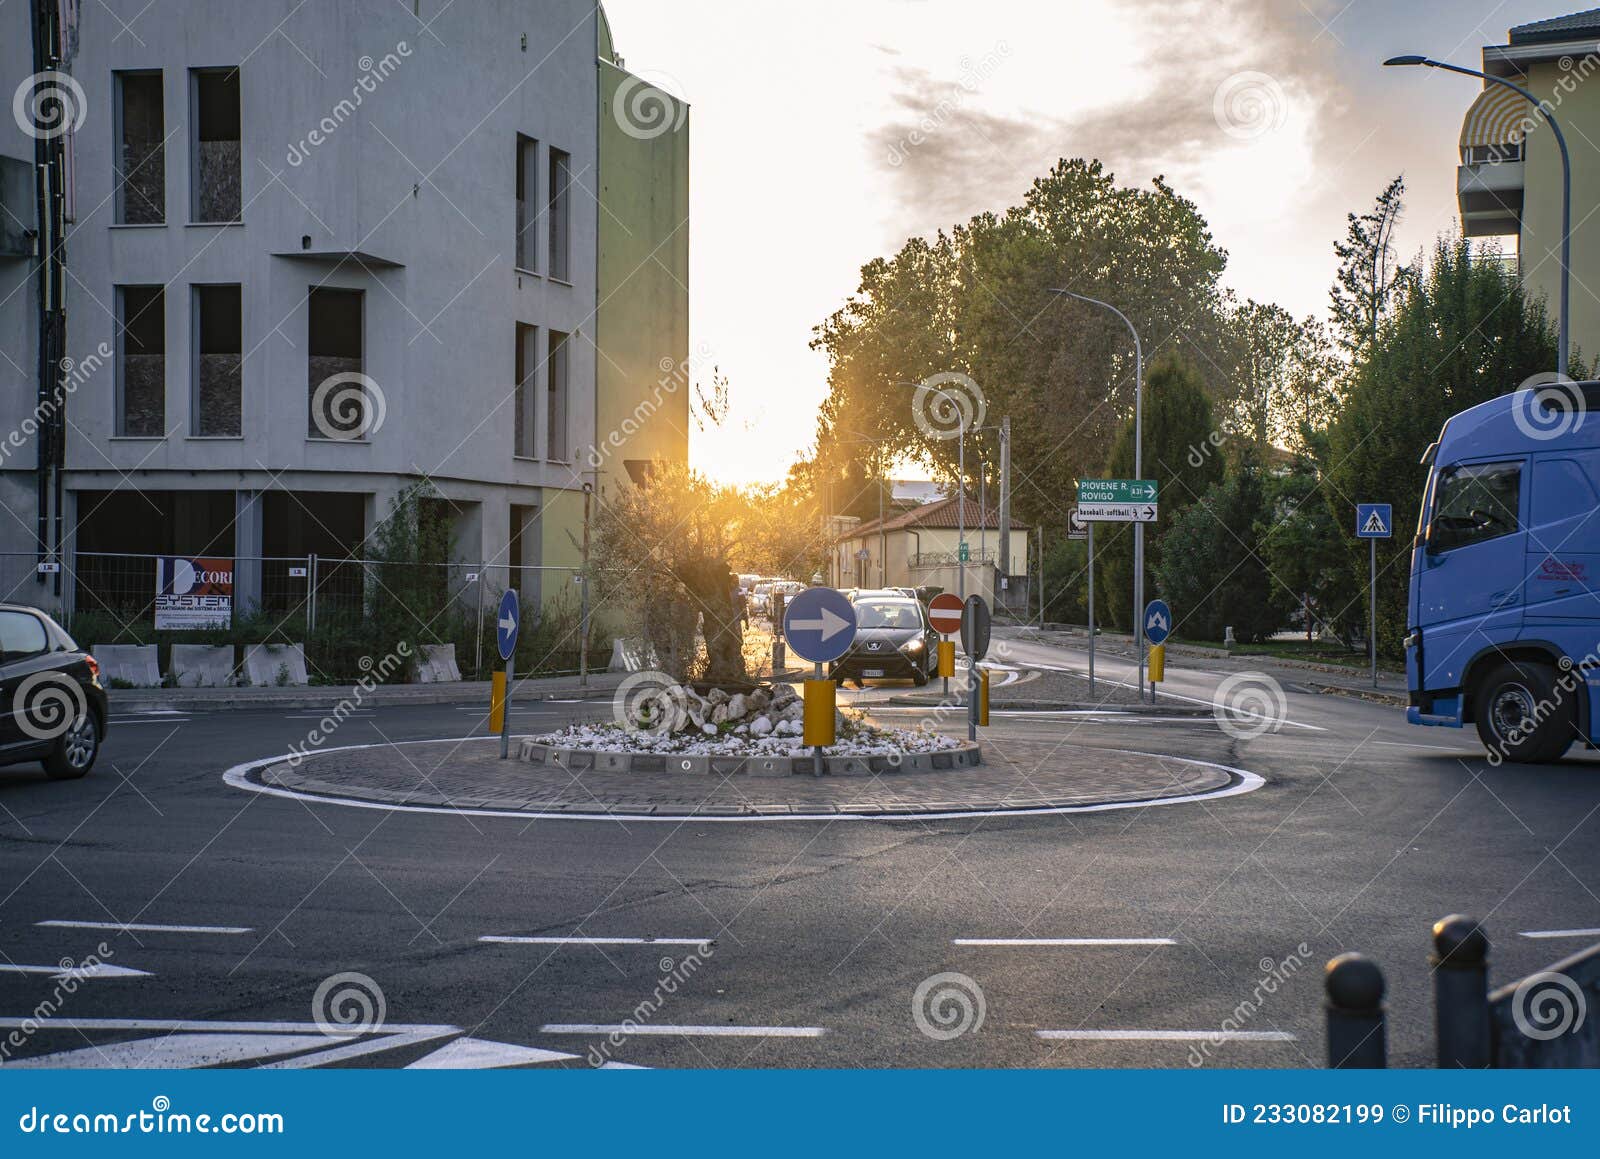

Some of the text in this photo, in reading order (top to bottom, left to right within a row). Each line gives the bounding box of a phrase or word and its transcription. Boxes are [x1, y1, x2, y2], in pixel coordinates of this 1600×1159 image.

[1081, 482, 1129, 490] PIOVENE R.
[1081, 492, 1114, 500] ROVIGO
[156, 595, 231, 606] SYSTEM
